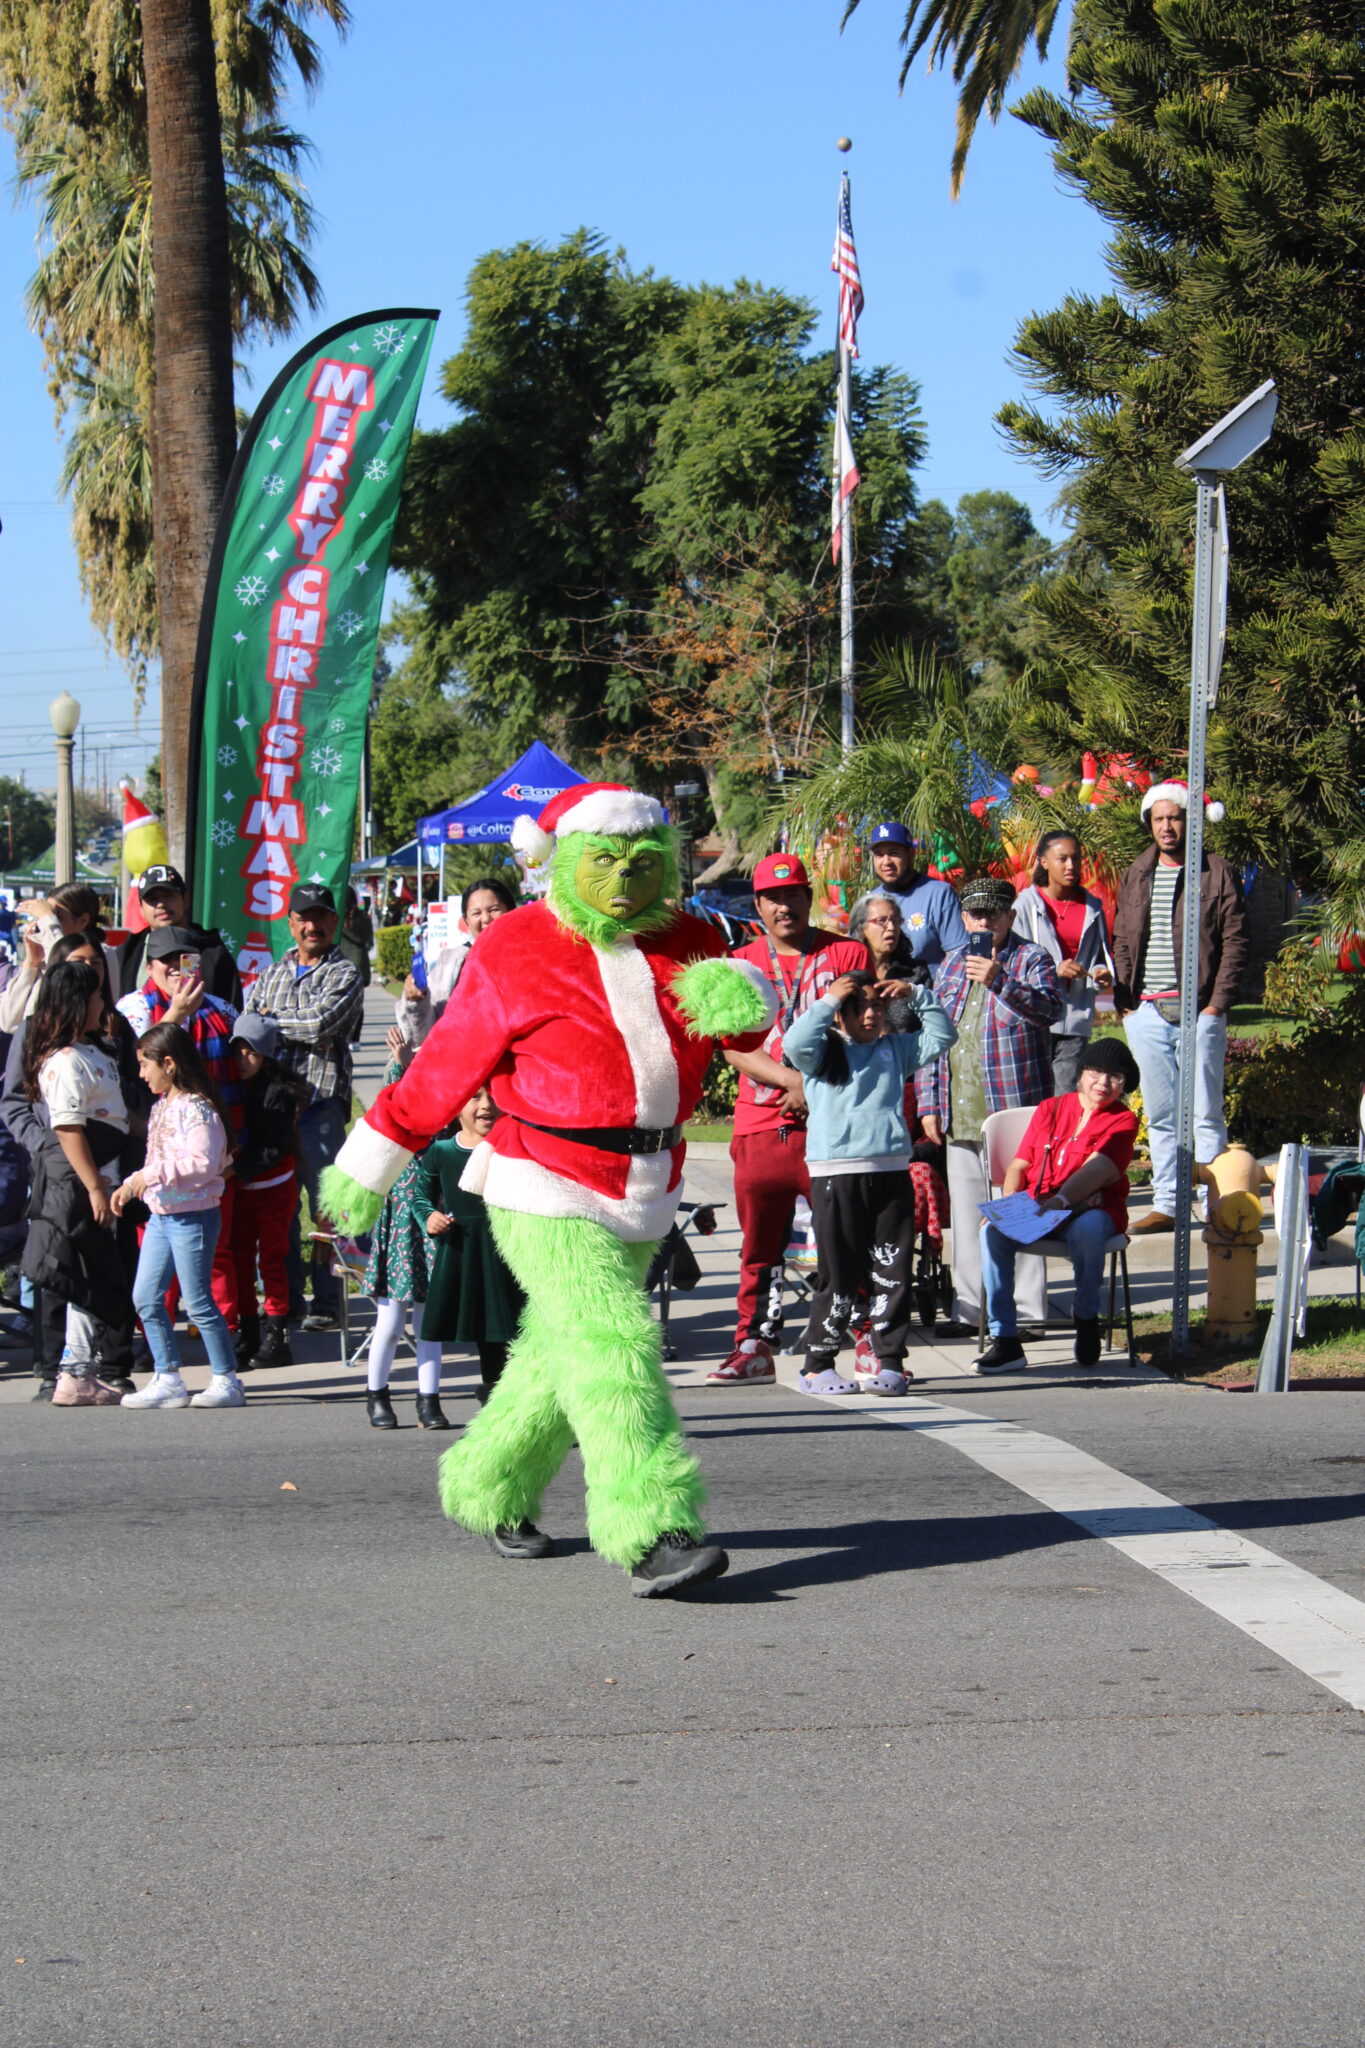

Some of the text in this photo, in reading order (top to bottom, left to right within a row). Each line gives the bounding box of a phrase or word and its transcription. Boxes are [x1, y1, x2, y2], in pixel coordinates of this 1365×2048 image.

[248, 363, 368, 916] MERRY CHRISTMAS
[467, 822, 513, 837] @Colto
[878, 824, 890, 838] LA
